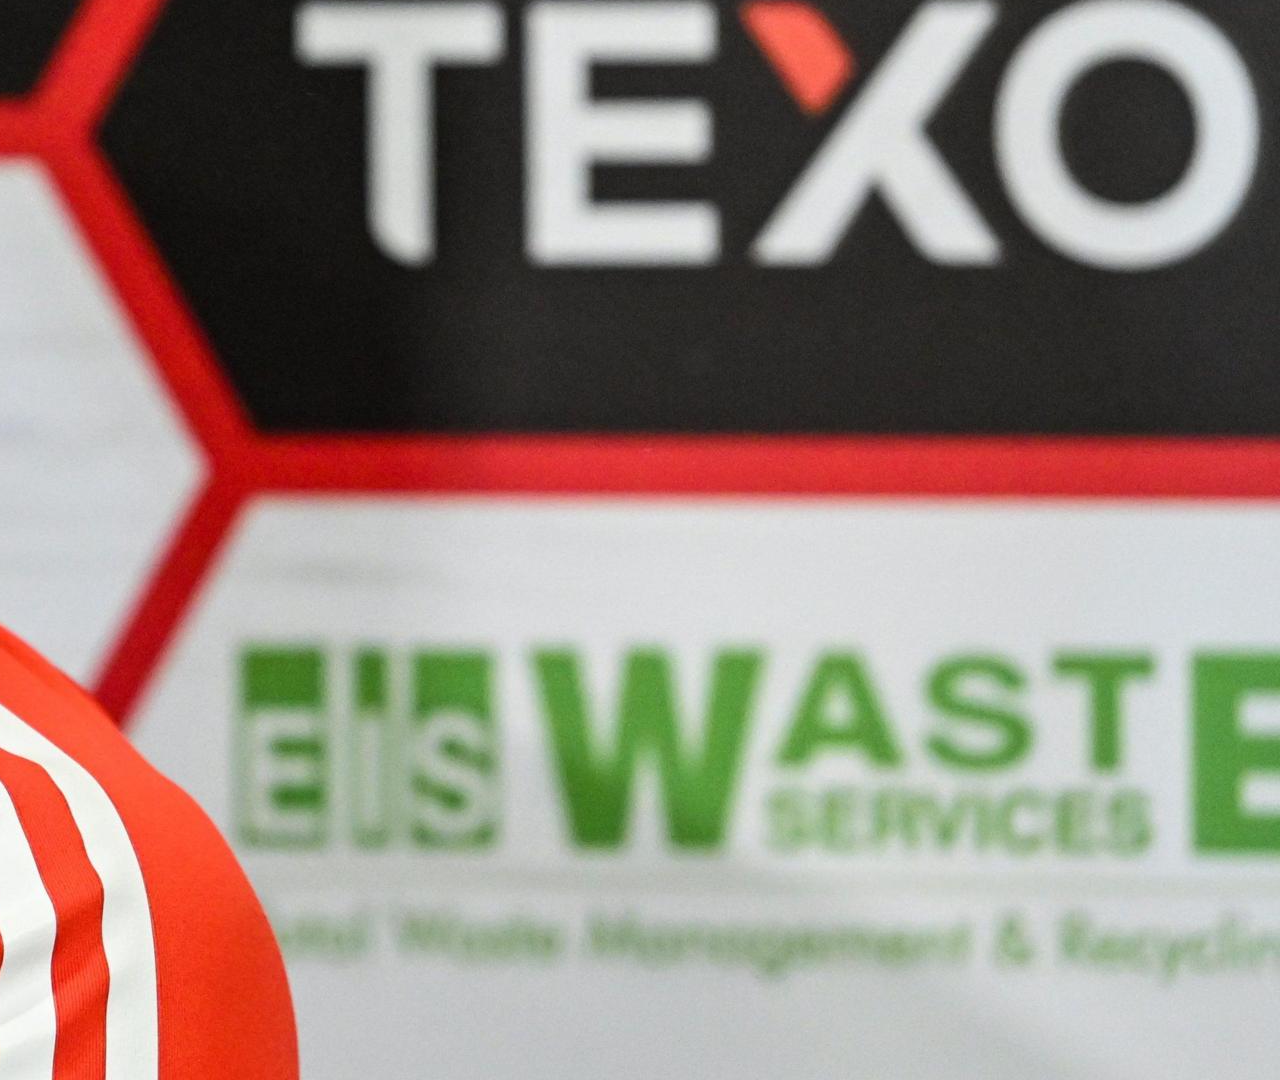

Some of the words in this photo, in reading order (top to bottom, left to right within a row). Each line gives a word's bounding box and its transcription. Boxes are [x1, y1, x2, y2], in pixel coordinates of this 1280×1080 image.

[240, 680, 496, 848] EIS
[760, 786, 1154, 854] SERVICES
[585, 908, 972, 980] Management
[993, 908, 1034, 968] &
